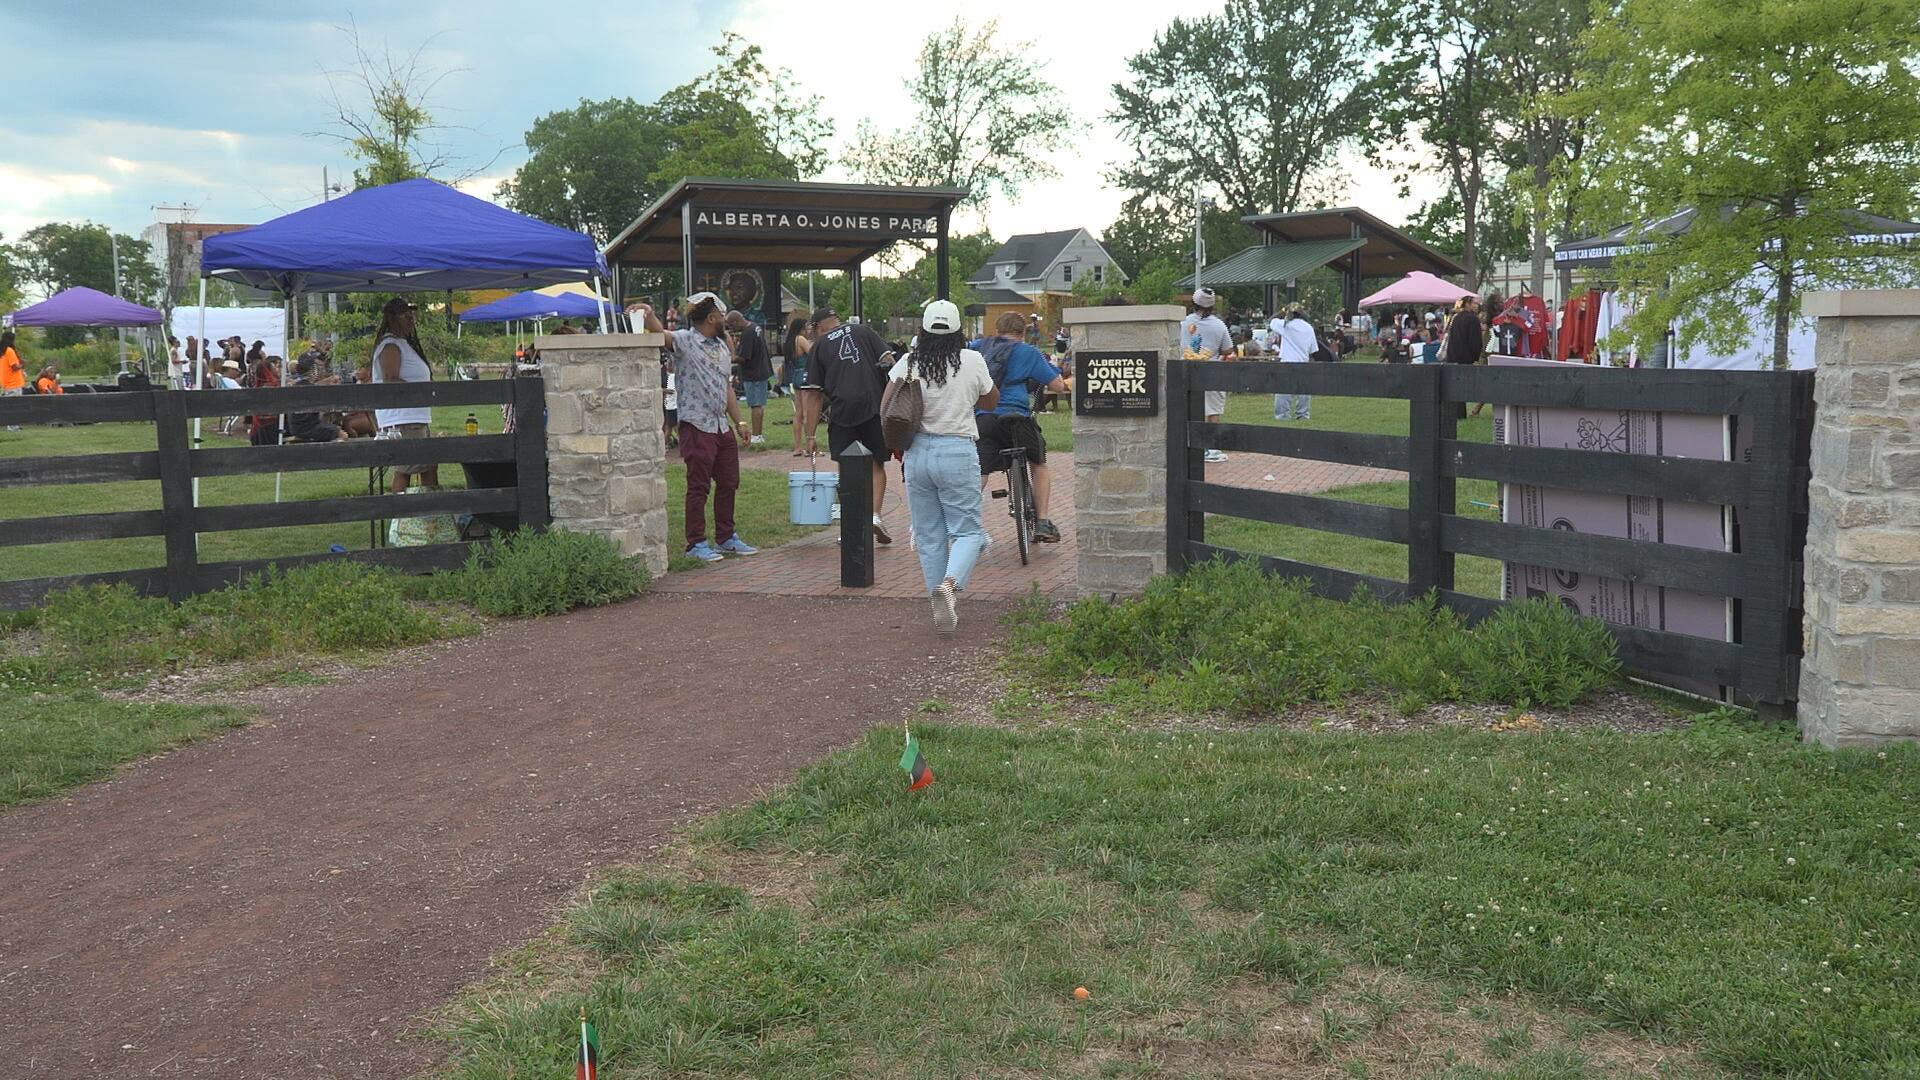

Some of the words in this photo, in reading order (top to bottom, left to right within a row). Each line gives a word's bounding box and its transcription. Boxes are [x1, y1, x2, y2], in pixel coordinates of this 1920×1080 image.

[696, 212, 790, 227] ALBERTA
[796, 214, 814, 227] O.
[819, 215, 880, 229] JONES
[839, 334, 859, 363] 4
[1087, 367, 1146, 379] JONES
[1088, 380, 1146, 393] PARK
